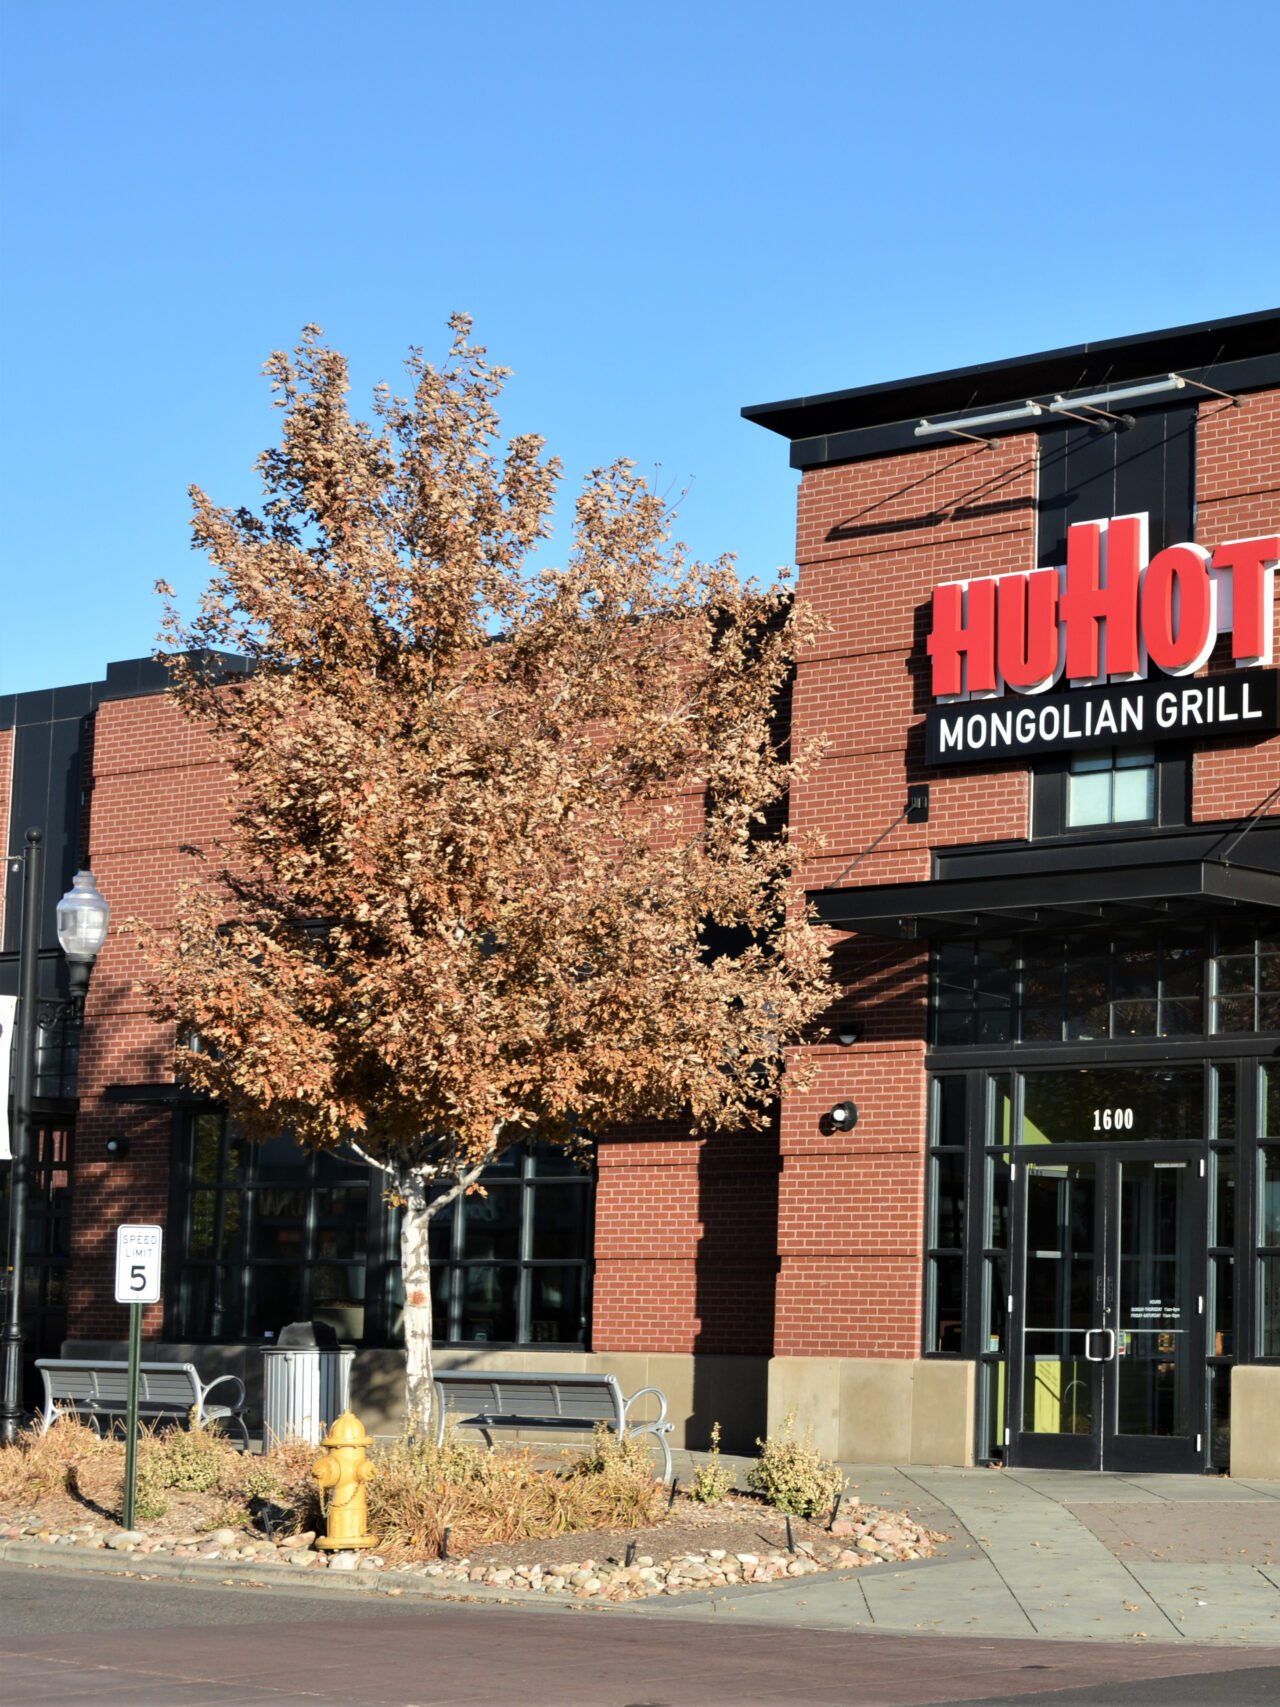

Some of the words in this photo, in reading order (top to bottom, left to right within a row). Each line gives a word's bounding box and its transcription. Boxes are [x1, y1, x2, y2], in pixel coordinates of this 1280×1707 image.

[939, 695, 1144, 752] MONGOLIAN
[1156, 682, 1263, 728] GRILL
[1093, 1108, 1133, 1131] 1600
[122, 1235, 158, 1245] SPEED
[125, 1248, 153, 1258] LIMIT
[130, 1265, 147, 1292] 5
